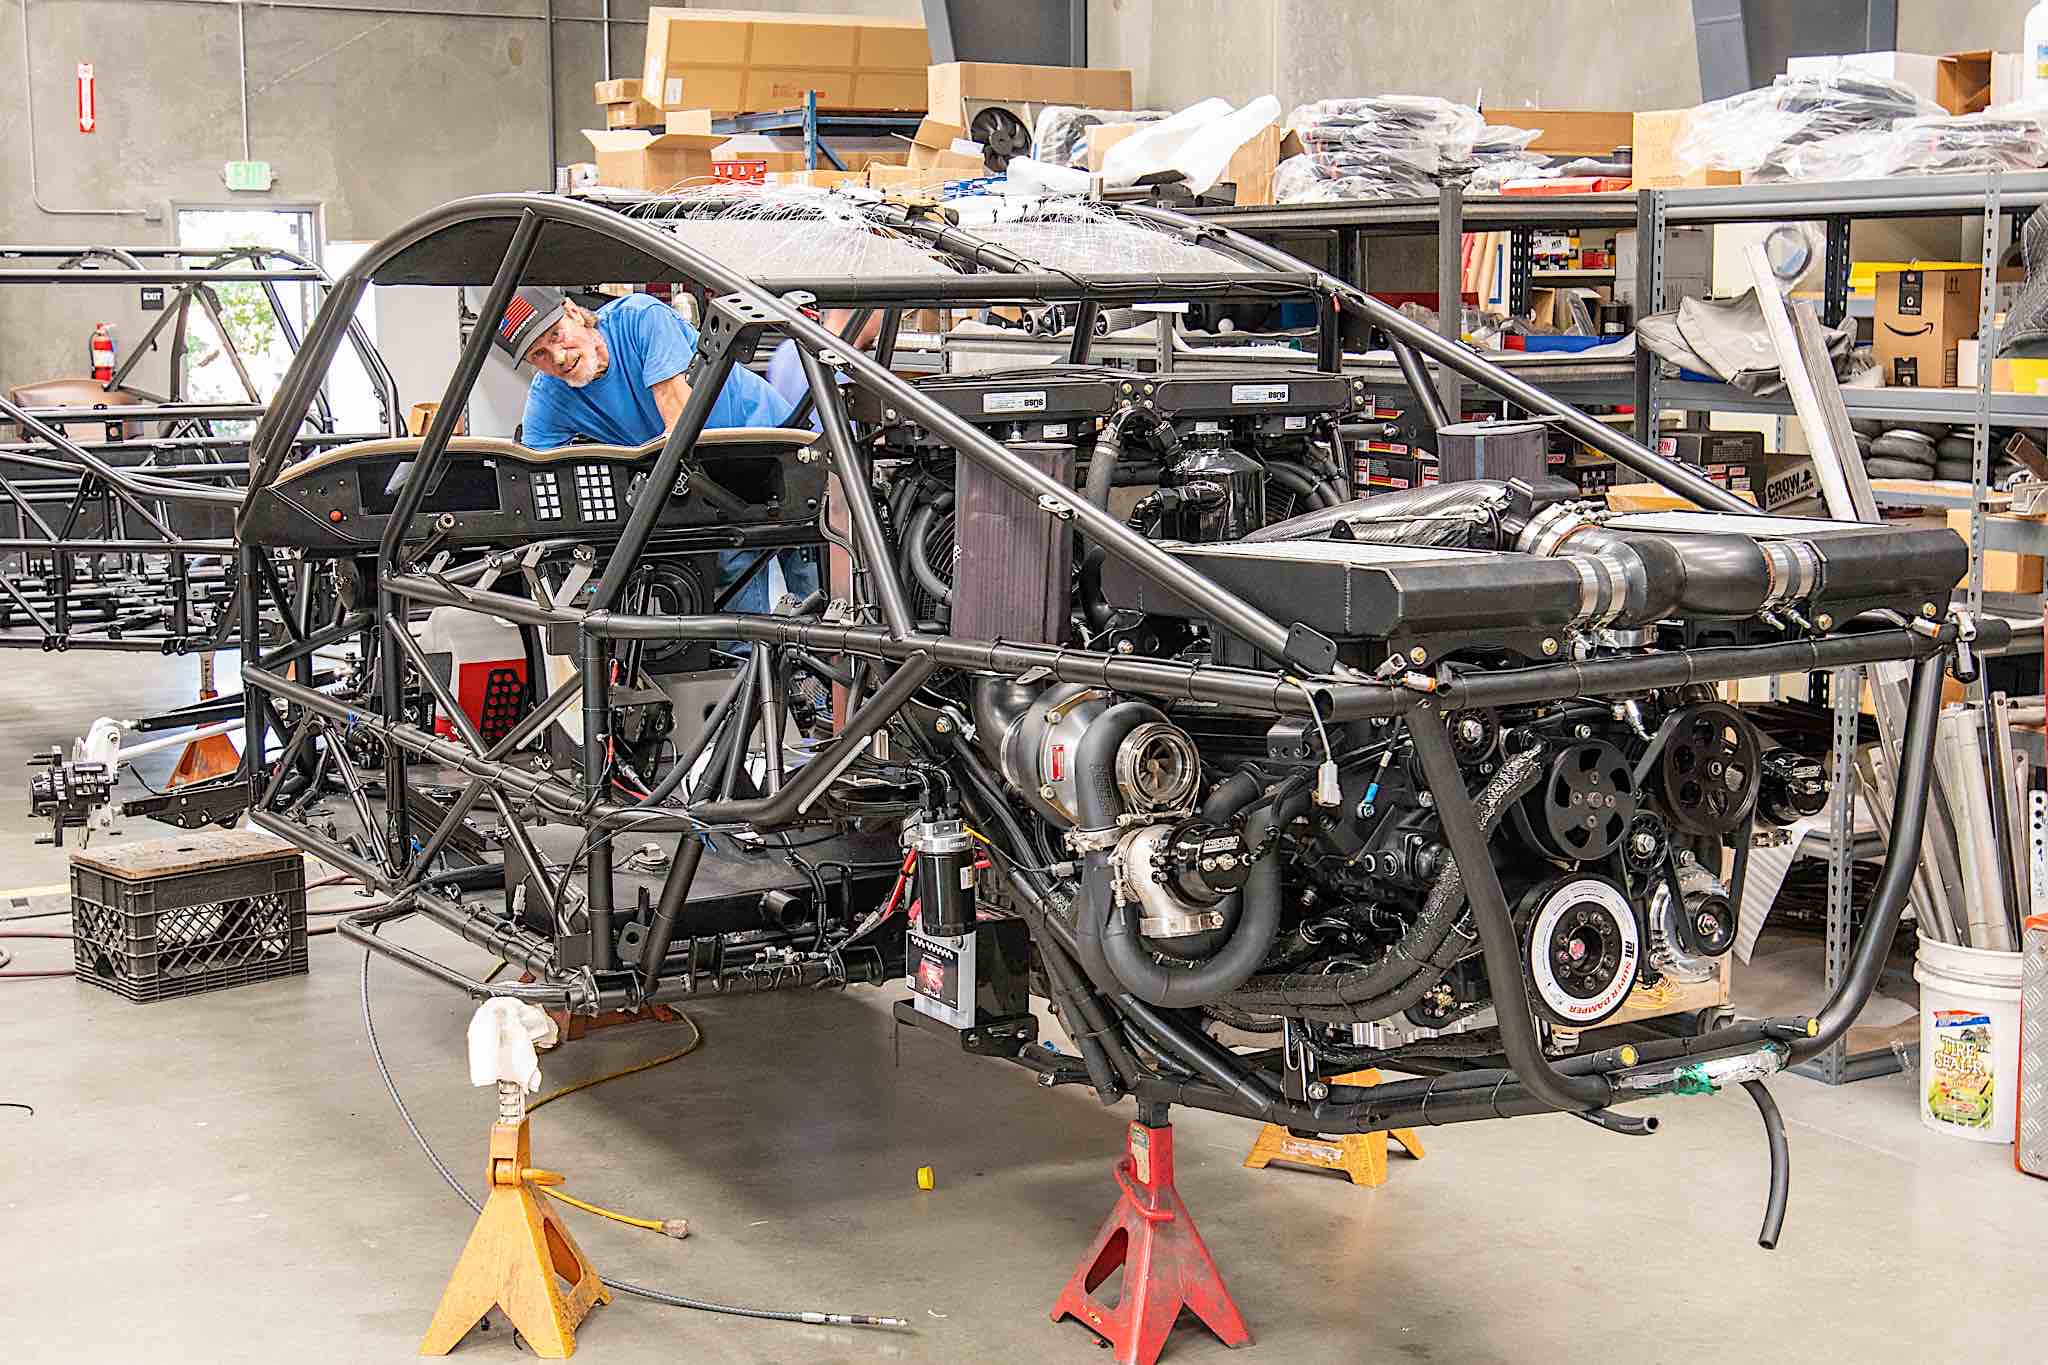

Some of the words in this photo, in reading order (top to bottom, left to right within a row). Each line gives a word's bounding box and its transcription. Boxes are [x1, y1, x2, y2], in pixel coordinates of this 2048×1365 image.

[143, 292, 162, 300] EXIT
[1768, 474, 1801, 499] CROW
[1768, 489, 1797, 505] SAFETY
[1796, 481, 1814, 495] GEAR
[1611, 961, 1632, 999] SUPER
[1569, 994, 1612, 1014] DAMPER
[1940, 1034, 1978, 1058] TIRE
